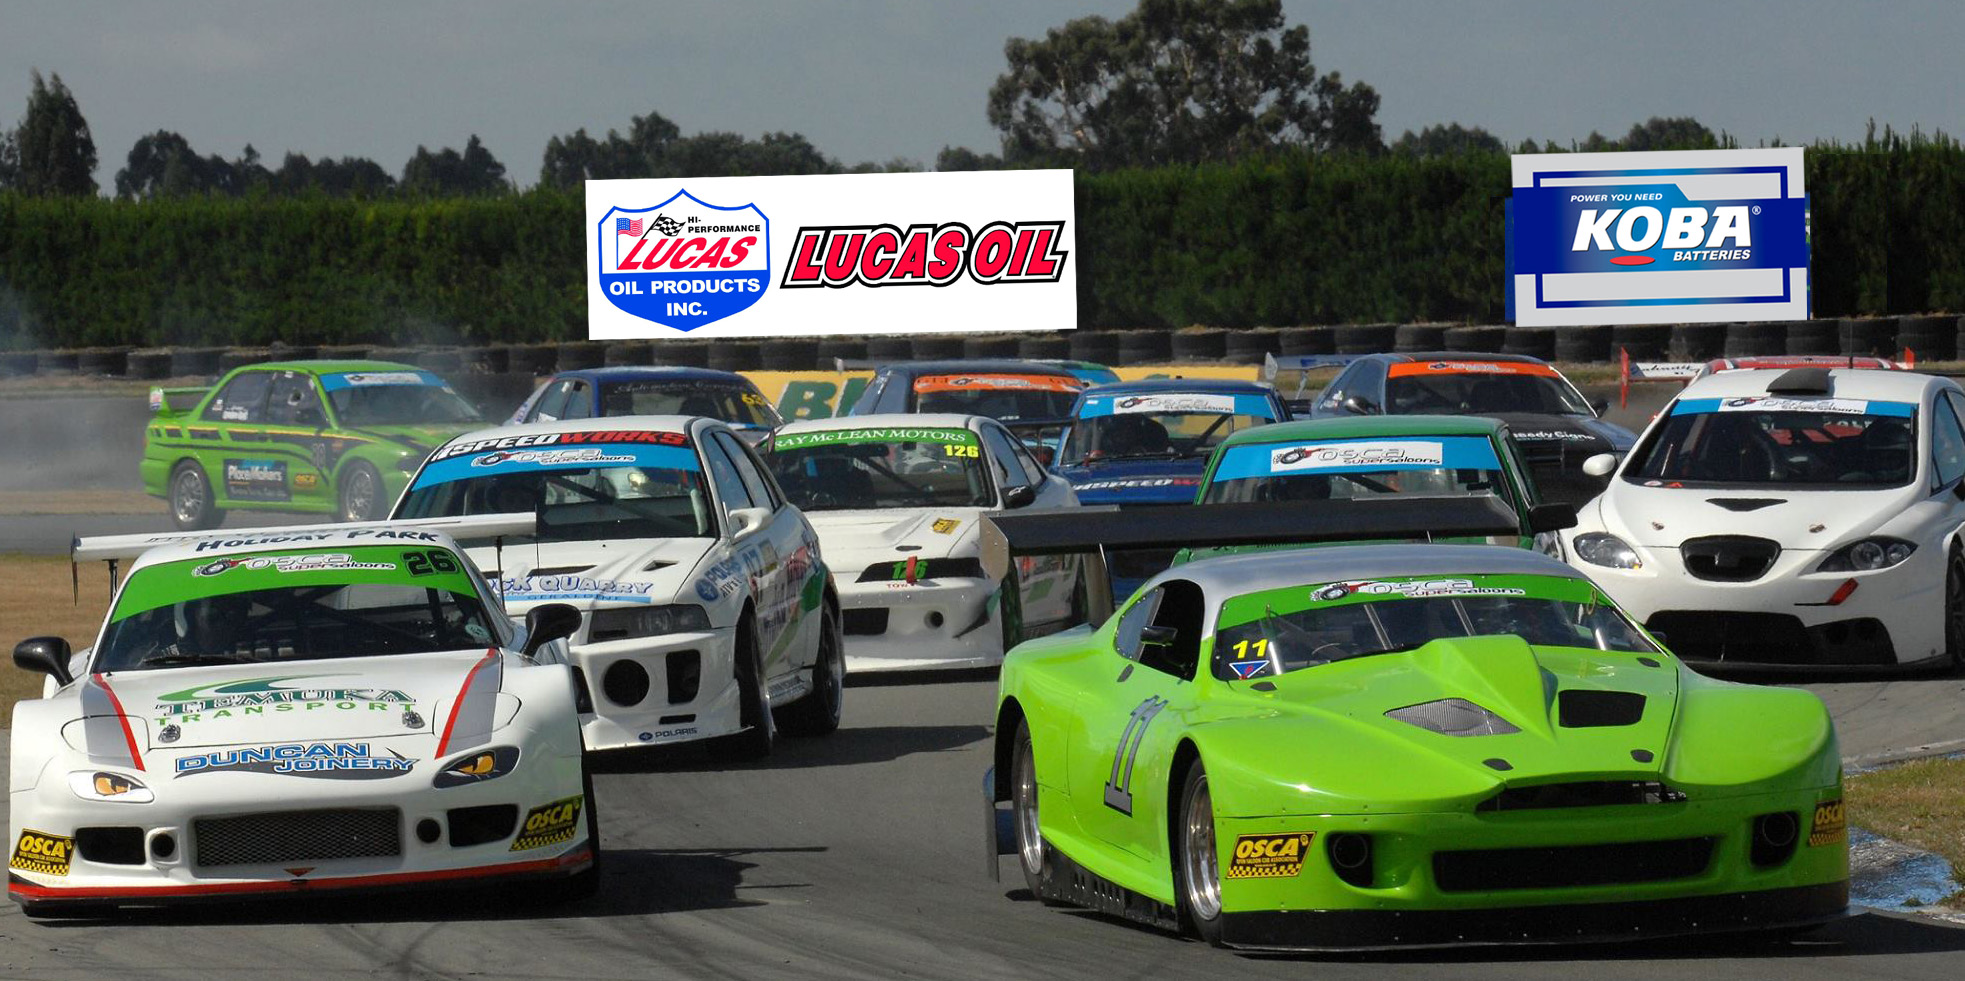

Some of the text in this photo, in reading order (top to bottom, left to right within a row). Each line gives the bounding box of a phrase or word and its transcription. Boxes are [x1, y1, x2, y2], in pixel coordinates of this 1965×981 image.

[1570, 193, 1663, 202] POWER YOU NEED
[687, 216, 701, 224] HI-
[687, 224, 761, 233] PERFORMANCE
[1572, 205, 1752, 252] KOBA
[617, 236, 758, 270] LUCAS
[784, 226, 1061, 284] LUCAS OIL
[1673, 249, 1752, 262] BATTERIES
[609, 278, 761, 296] OIL PRODUCTS
[666, 302, 708, 317] INC.
[775, 435, 808, 448] RAY
[888, 428, 967, 442] MOTORS
[943, 444, 980, 458] 126
[1343, 455, 1442, 466] supersaloons
[195, 533, 334, 552] HOLIDAY
[346, 529, 441, 542] PARK
[277, 561, 396, 573] supersaloons
[401, 550, 460, 577] 26
[539, 575, 654, 594] QUARRY
[1403, 588, 1525, 598] supersaloons
[1233, 638, 1268, 659] 11
[154, 701, 416, 726] TRANSPORT
[655, 727, 698, 738] POLARIS
[175, 742, 371, 774] DUNCAN
[272, 756, 421, 774] JOINERY
[1104, 694, 1169, 818] 11
[526, 803, 574, 832] OSCA
[19, 835, 66, 858] OSCA
[1236, 837, 1300, 859] OSCA
